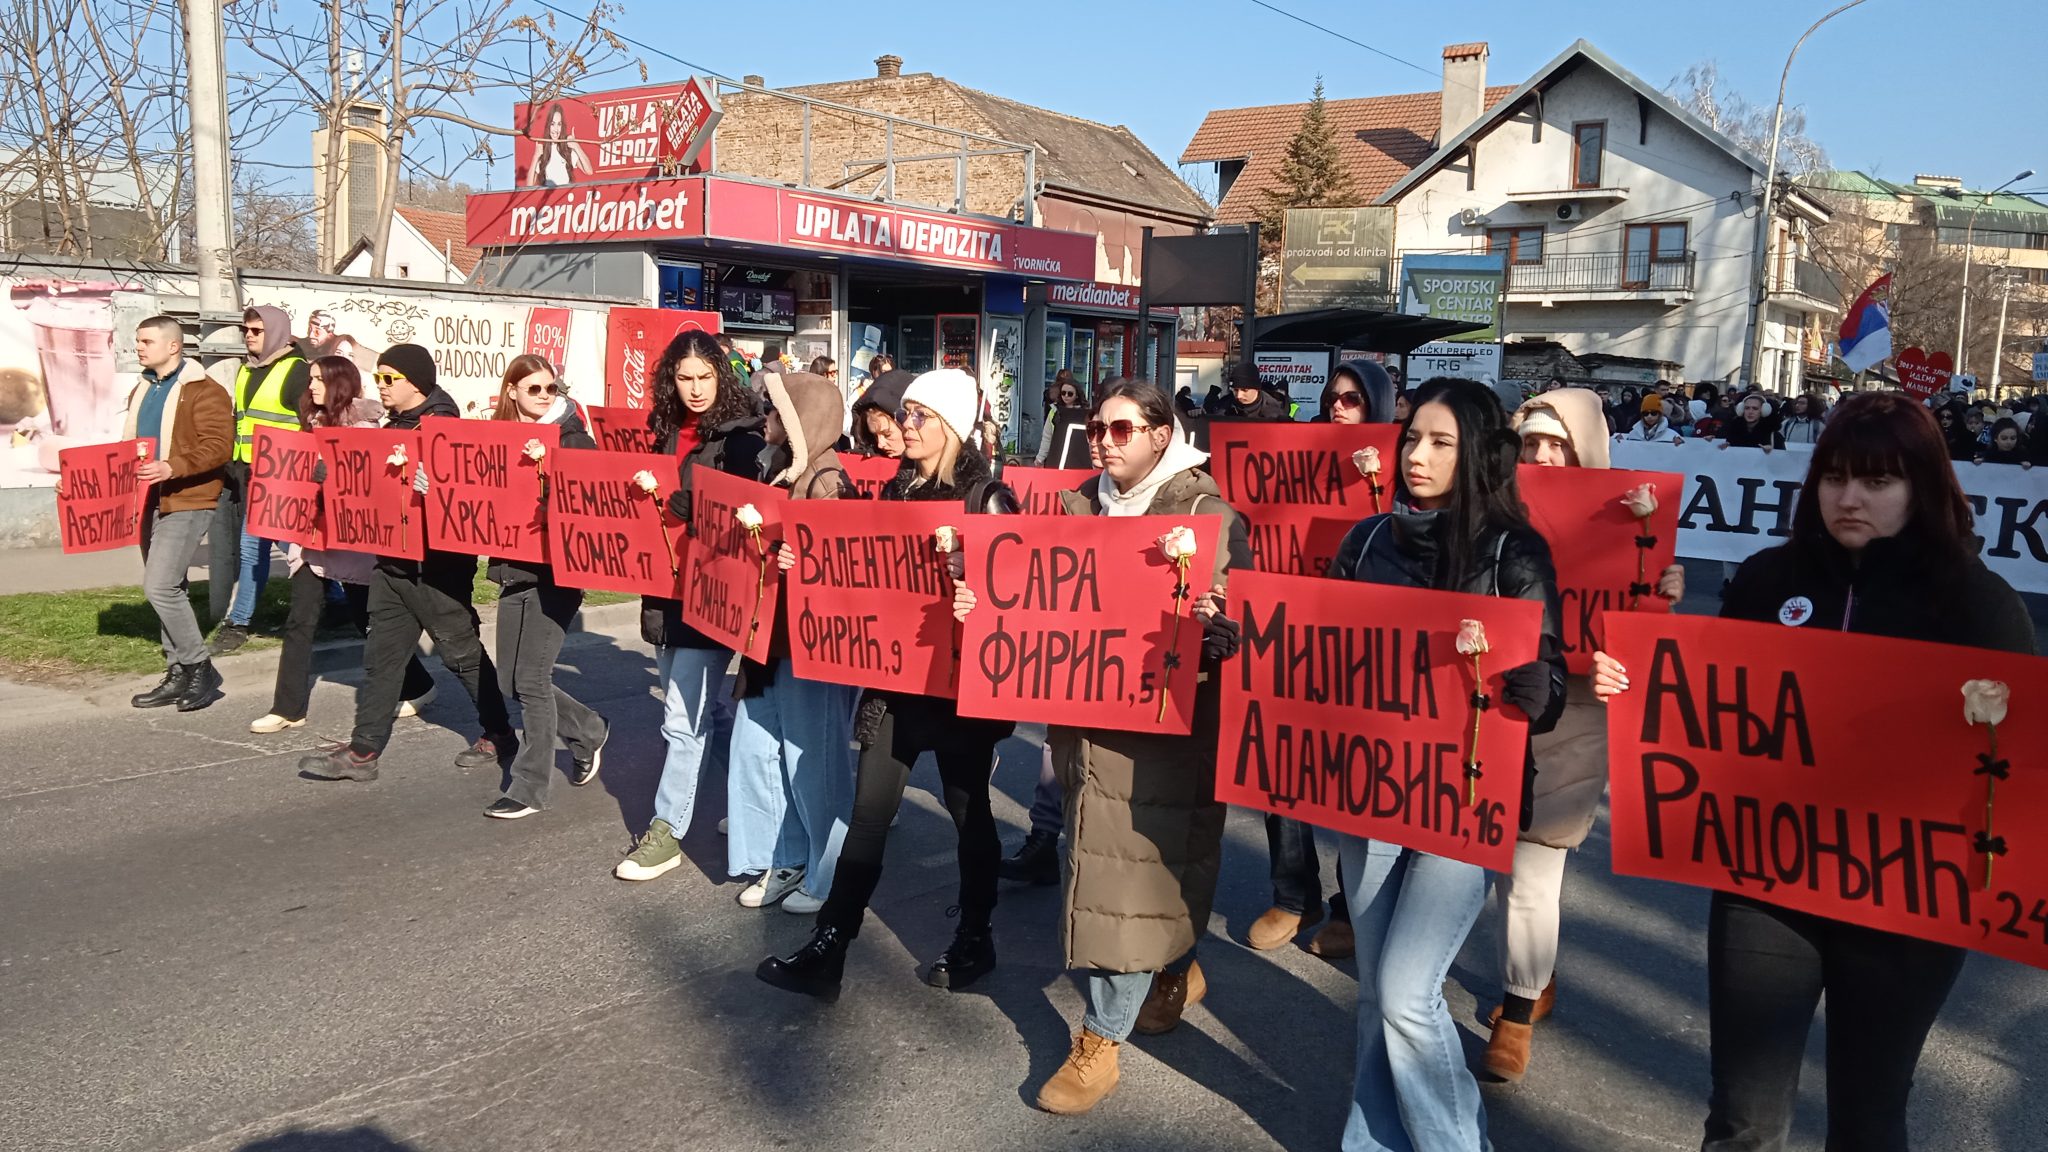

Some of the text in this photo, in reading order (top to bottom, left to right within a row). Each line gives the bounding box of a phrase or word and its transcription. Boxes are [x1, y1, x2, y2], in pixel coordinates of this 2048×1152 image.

[666, 91, 698, 142] UPLATA
[671, 102, 704, 151] DEPOZITA
[510, 187, 688, 236] meridianbet
[796, 203, 1003, 262] UPLATA DEPOZITA
[1287, 247, 1387, 259] proizvodi od klirita
[1053, 283, 1130, 307] meridianbet
[1423, 278, 1495, 294] SPORTSKI
[1436, 295, 1493, 312] CENTAR
[434, 314, 516, 347] OBIČNO JE
[533, 323, 565, 349] 80%
[1447, 347, 1493, 356] PREGLED
[434, 349, 506, 378] RADOSNO
[1258, 364, 1313, 373] БЕСПЛАТАН
[1288, 375, 1326, 384] ПРЕВОЗ
[1426, 359, 1461, 371] TRG
[60, 460, 102, 501] САЊА
[325, 439, 372, 498] ЂУРО
[431, 432, 508, 489] СТЕФАН
[1225, 440, 1347, 506] ГОРАНКА
[554, 471, 640, 520] НЕМАЊА
[795, 523, 949, 598] ВАЛЕНТИНА
[985, 532, 1102, 612] САРА
[1241, 599, 1439, 720] МИЛИЦА
[1640, 637, 1815, 767] АЊА
